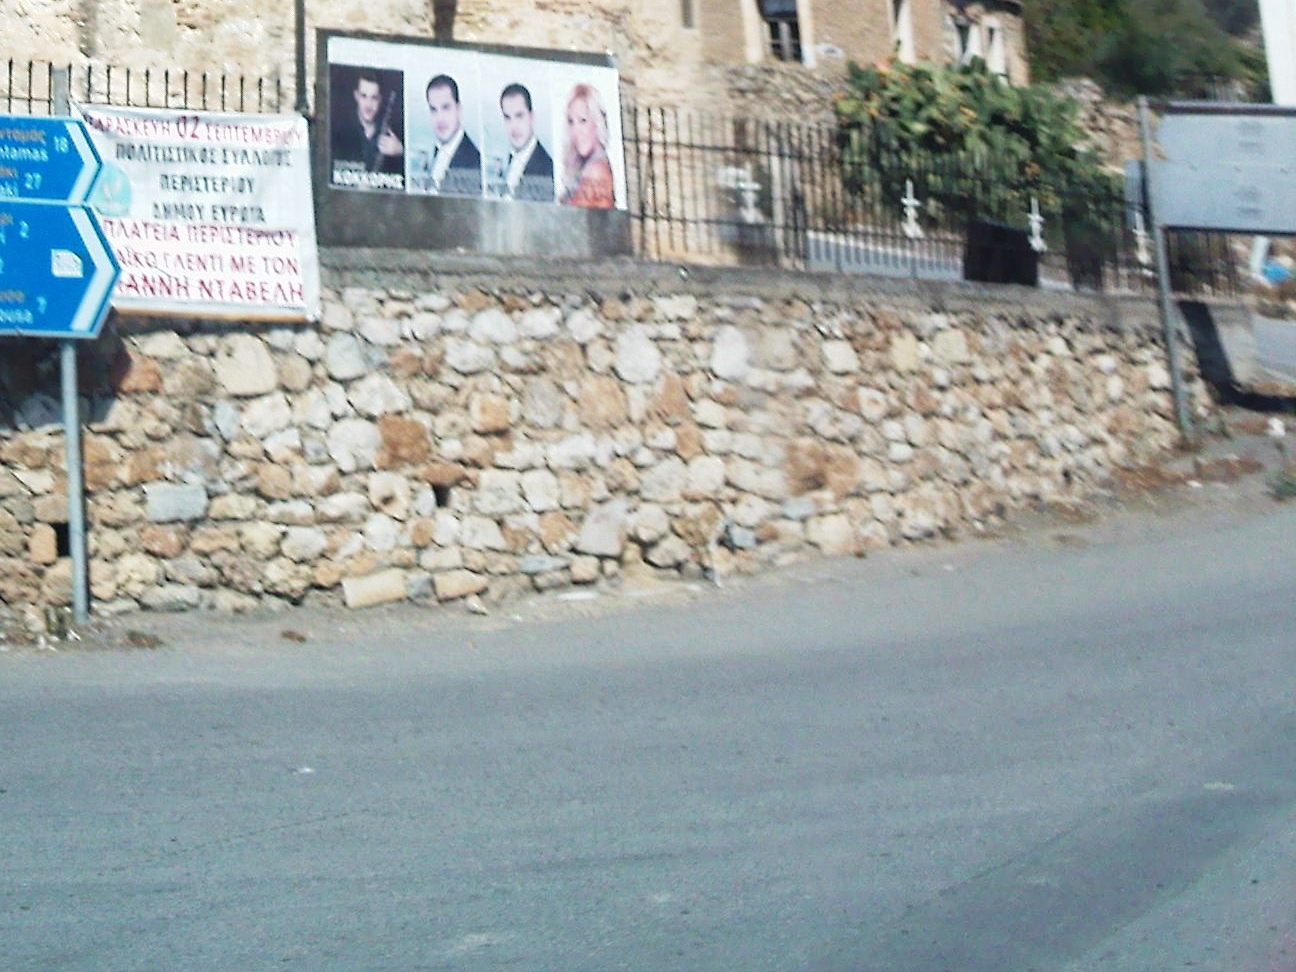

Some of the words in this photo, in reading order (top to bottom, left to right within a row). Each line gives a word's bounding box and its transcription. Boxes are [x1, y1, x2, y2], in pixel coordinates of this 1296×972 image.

[53, 137, 69, 154] 18
[160, 173, 255, 194] ΠΕΡΙΣΤΕΡΙΟΥ
[19, 220, 30, 239] 2
[103, 219, 180, 241] ΠΛΑΤΕΙΑ
[187, 222, 296, 247] ΠΕΡΙΣΤΕΡΙΟΥ
[163, 251, 225, 272] ΓΛΕΝΤΙ
[231, 254, 256, 274] ΜΕ
[263, 257, 299, 276] ΤΟΝ
[197, 278, 305, 304] ΝΤΑΒΕΛΗ
